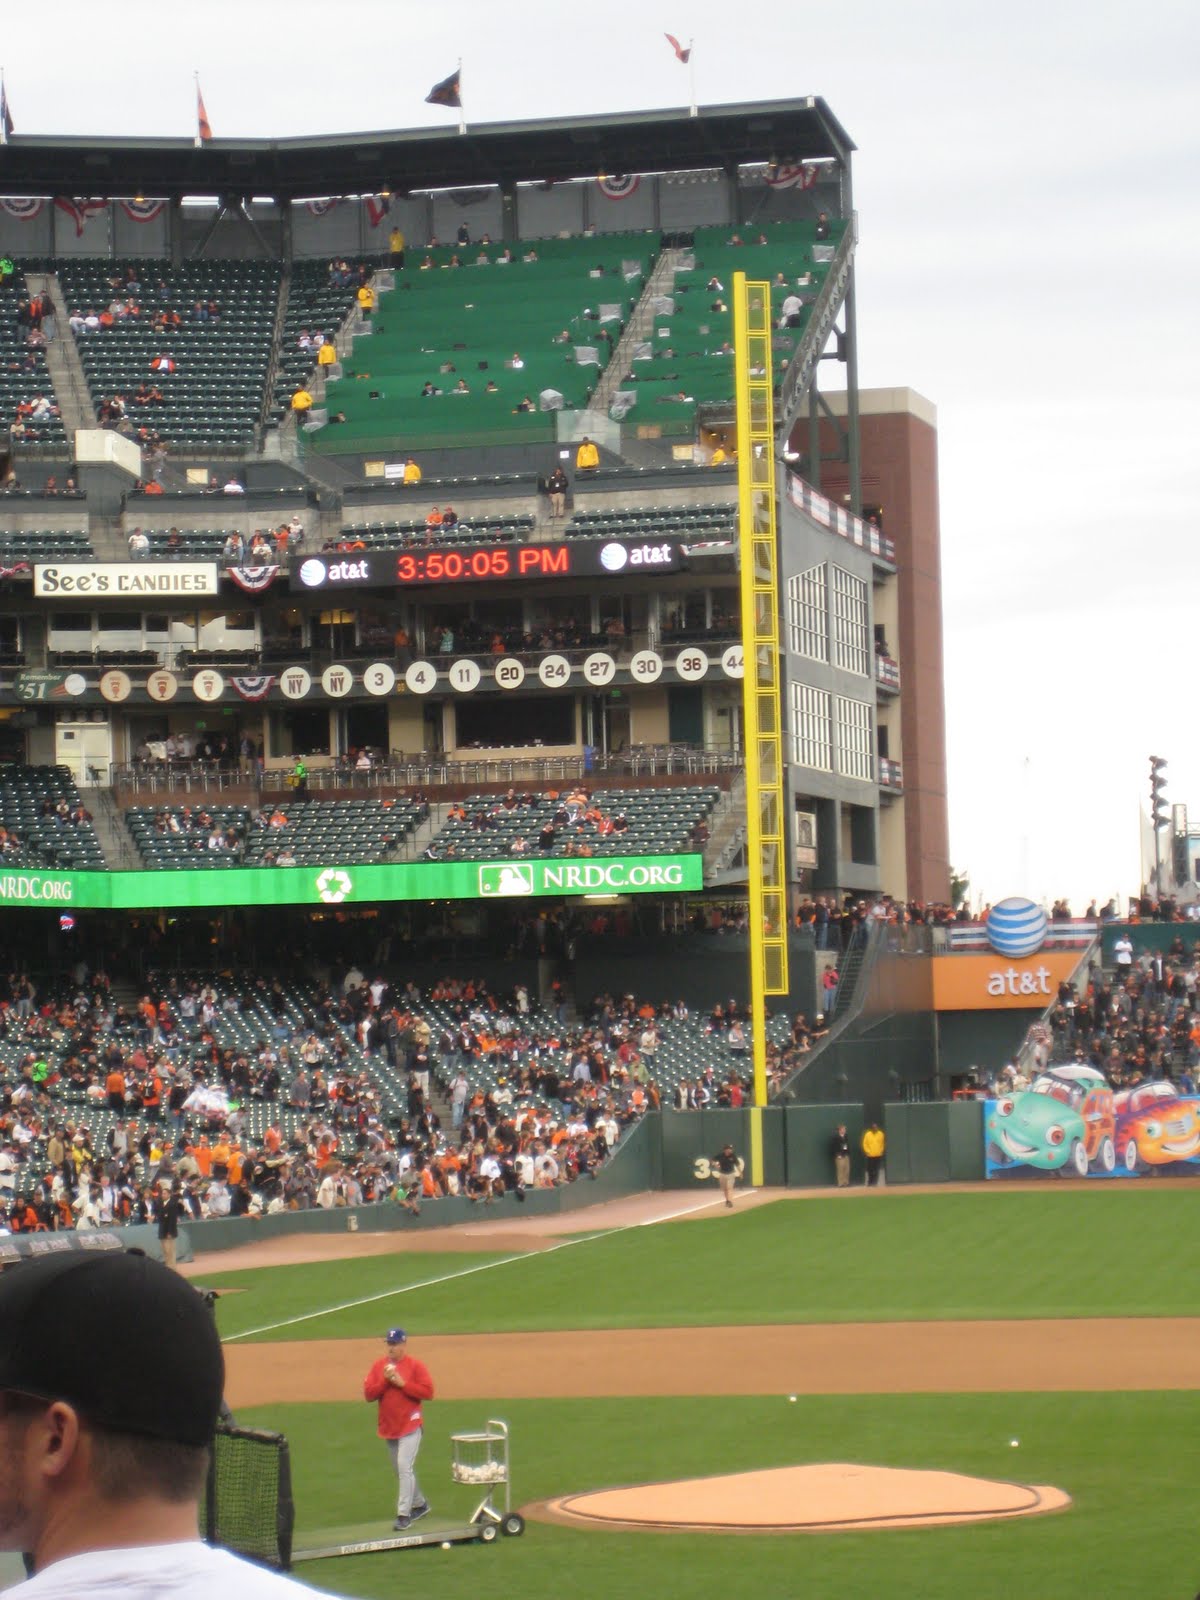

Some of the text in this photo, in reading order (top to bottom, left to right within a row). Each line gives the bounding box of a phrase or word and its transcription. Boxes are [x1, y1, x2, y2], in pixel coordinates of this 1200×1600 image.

[630, 543, 672, 564] at&t
[328, 560, 369, 580] at&t
[398, 547, 569, 580] 3:50:05 PM
[42, 568, 207, 592] See's CANDIES
[545, 664, 566, 679] 24
[589, 661, 610, 677] 27
[636, 659, 657, 674] 30
[682, 657, 702, 671] 36
[20, 673, 62, 681] Remember
[374, 672, 384, 687] 3
[414, 670, 426, 685] 4
[458, 669, 471, 683] 11
[500, 667, 519, 680] 20
[18, 682, 46, 699] '51
[288, 679, 303, 694] NY
[330, 677, 345, 693] NY
[543, 864, 684, 889] NRDC.ORG
[987, 966, 1051, 996] at&t
